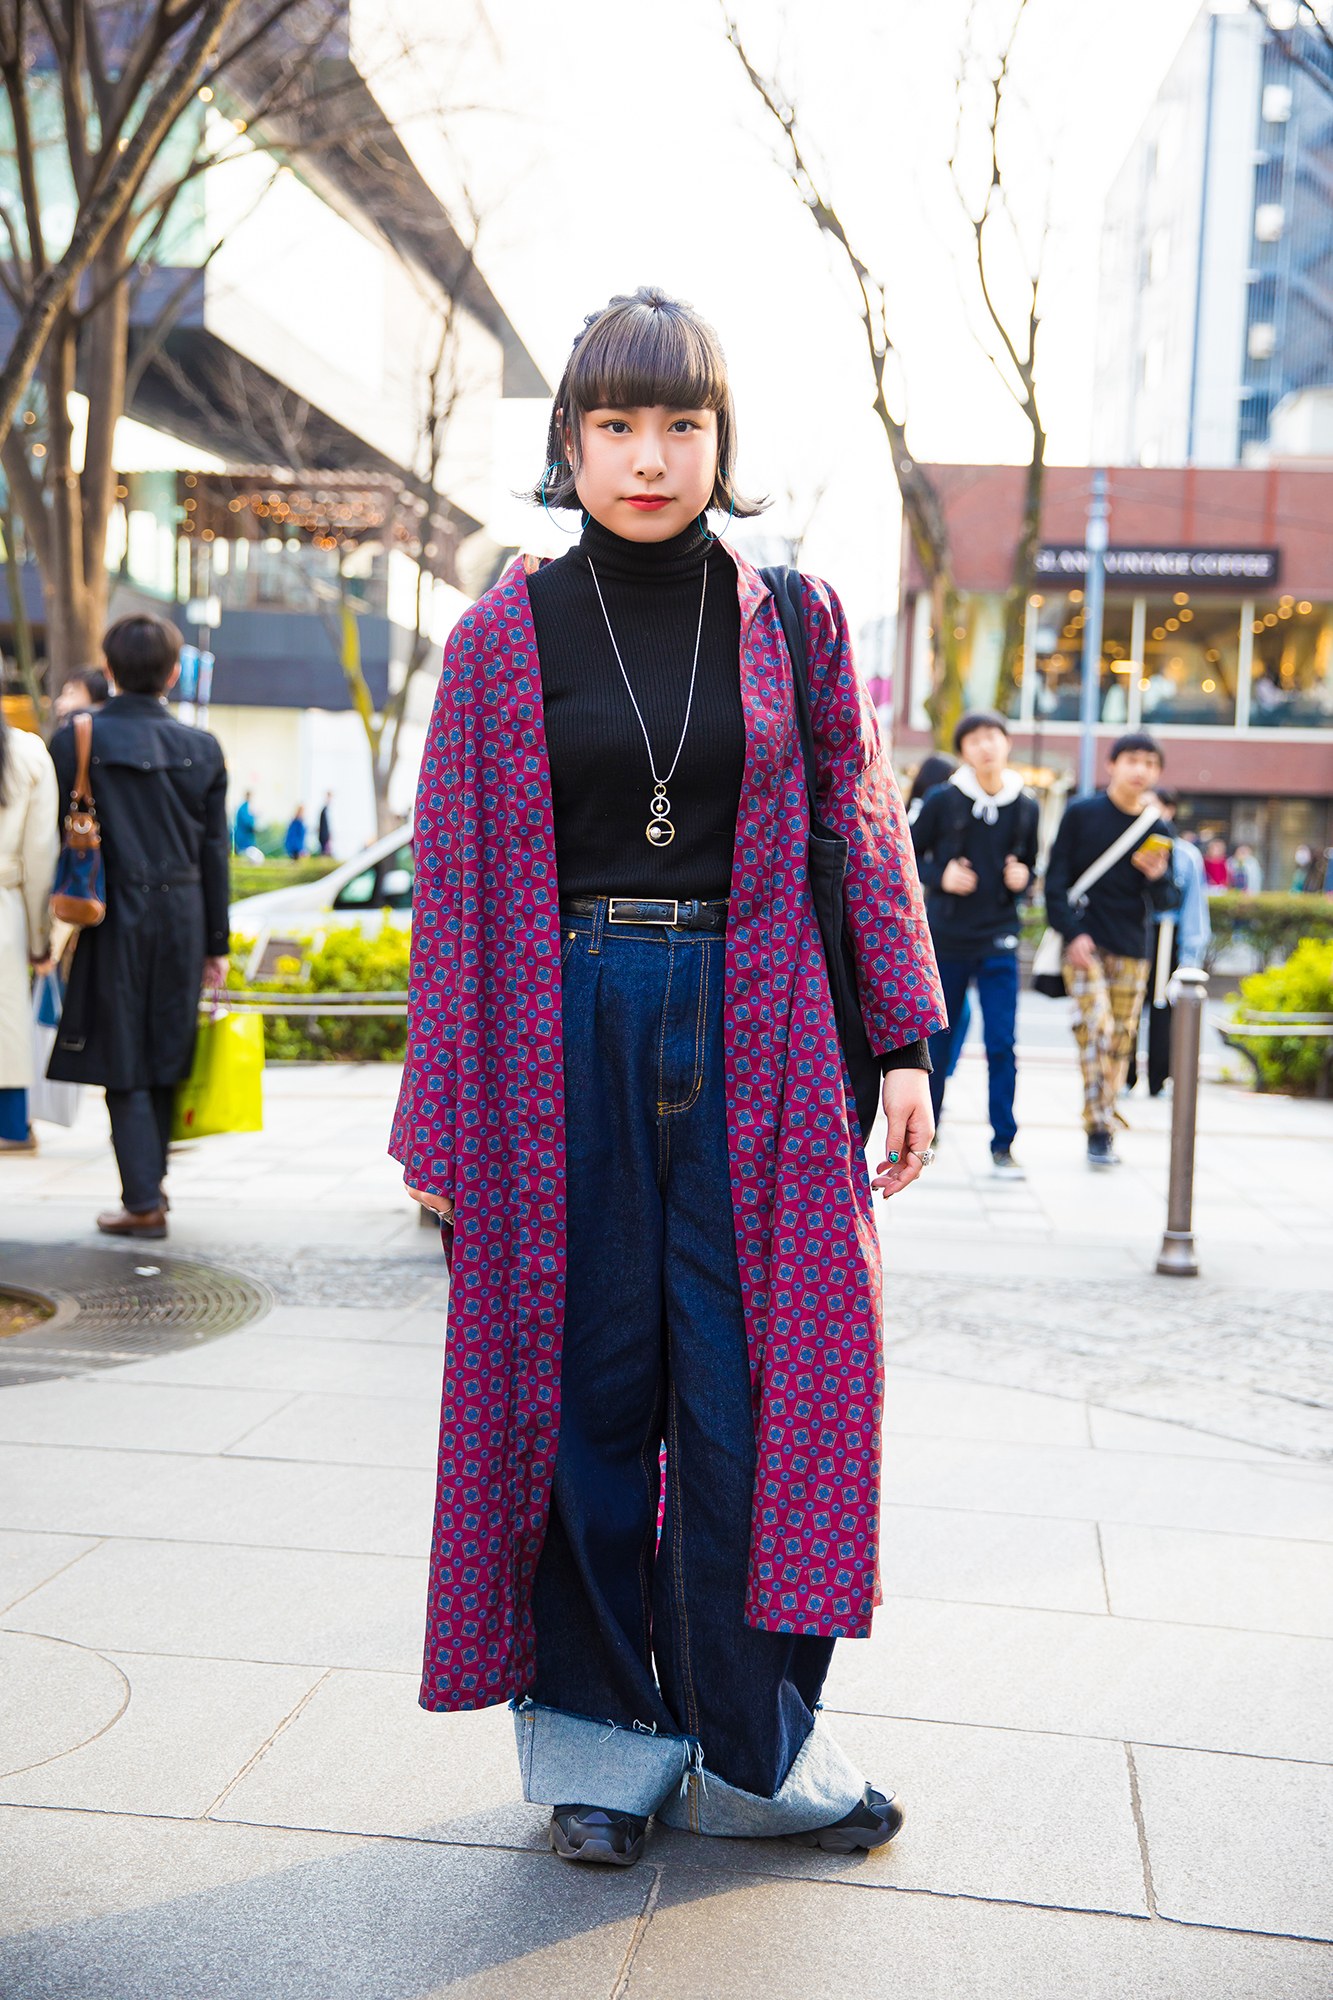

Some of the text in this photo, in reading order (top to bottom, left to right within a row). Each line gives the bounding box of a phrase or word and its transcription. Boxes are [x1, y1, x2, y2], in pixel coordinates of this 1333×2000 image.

[1034, 550, 1274, 577] SLAN VINTAGE COFFEE
